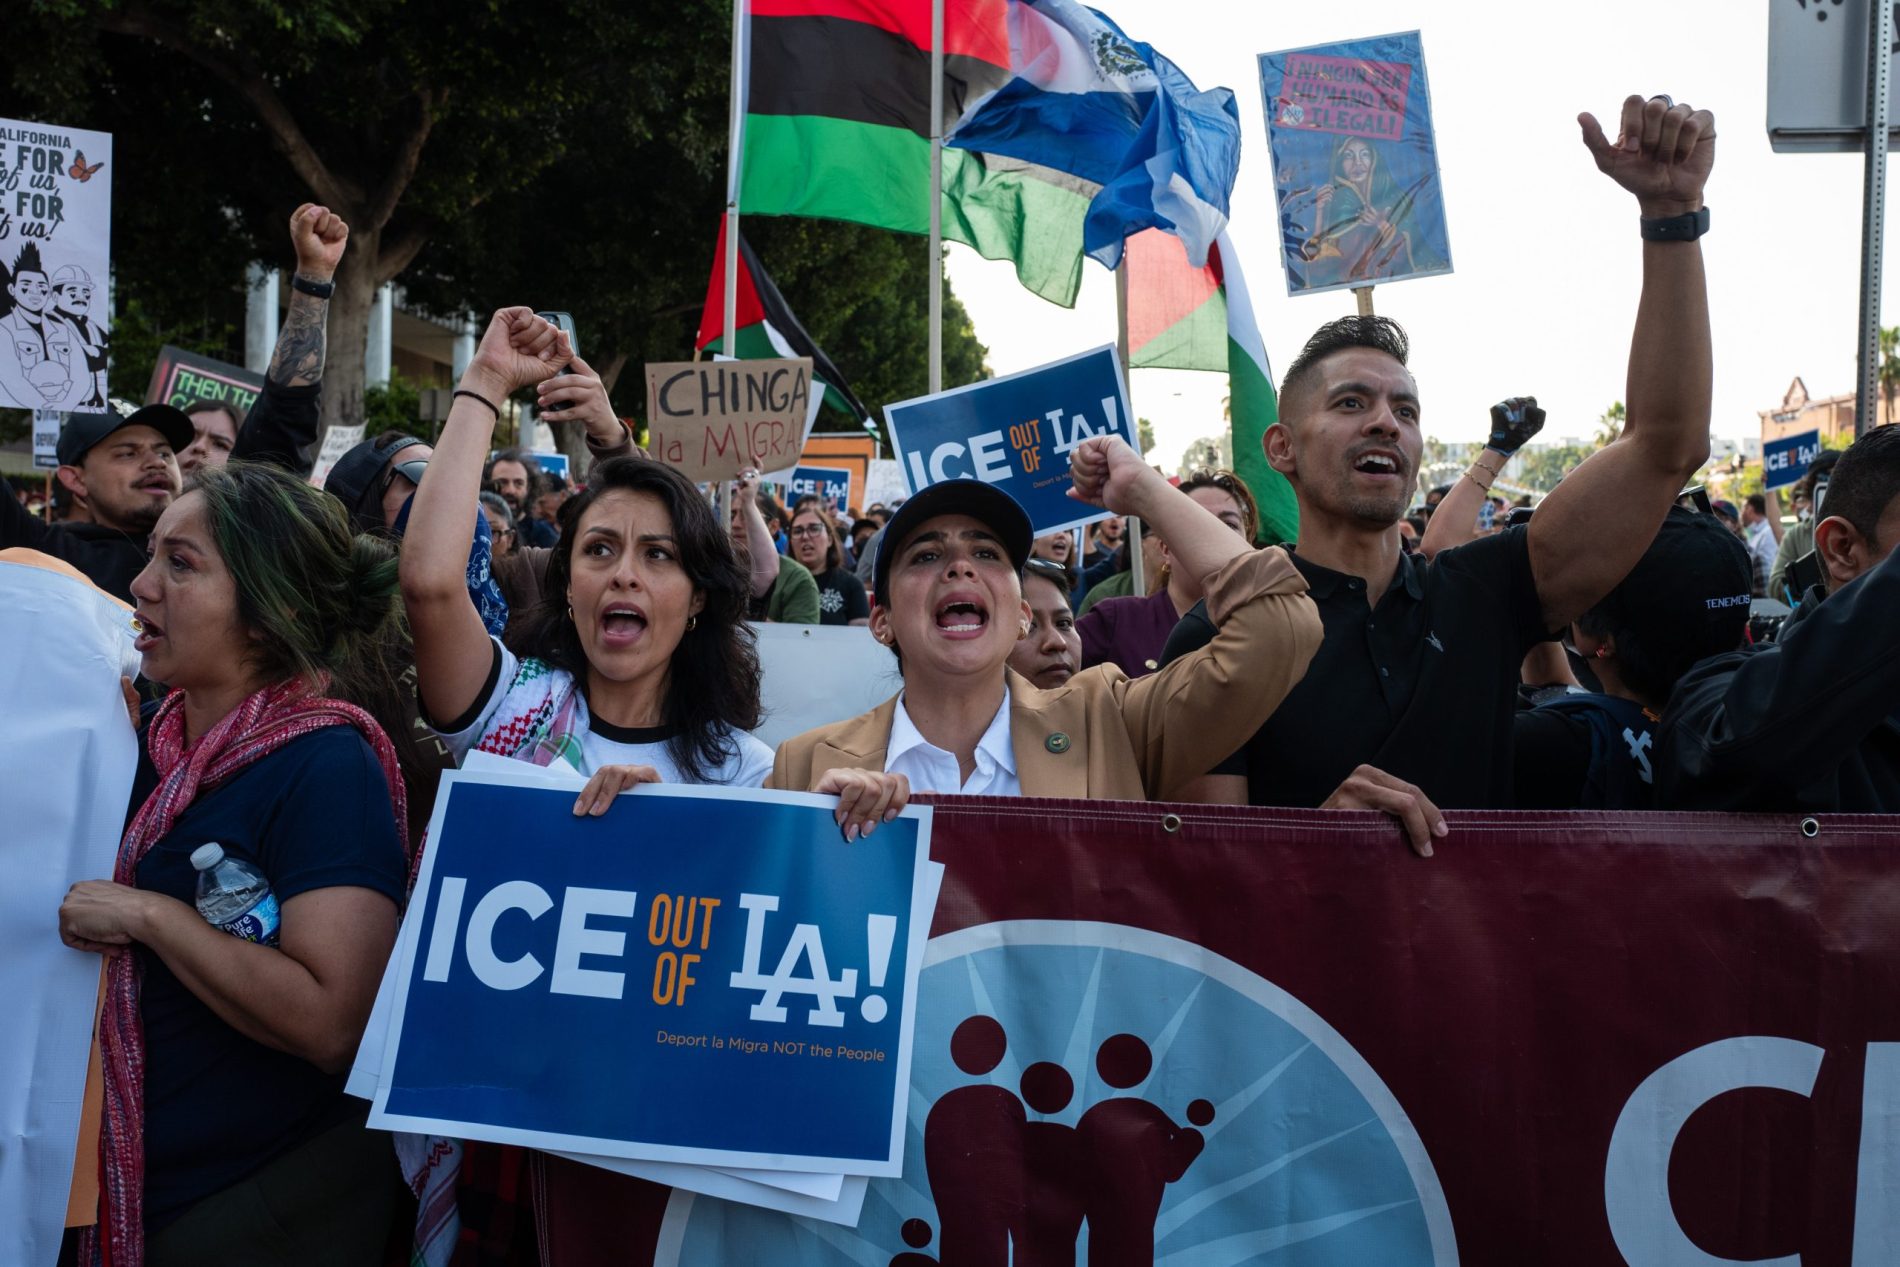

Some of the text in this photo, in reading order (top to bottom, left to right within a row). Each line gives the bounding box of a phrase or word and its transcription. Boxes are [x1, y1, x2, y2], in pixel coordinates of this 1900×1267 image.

[1311, 107, 1396, 135] ILEGAL!
[0, 127, 72, 149] ALIFORNIA
[17, 145, 65, 176] FOR
[16, 191, 65, 222] FOR
[177, 370, 258, 409] THEN TH
[658, 432, 683, 463] la
[1009, 419, 1041, 450] OUT
[907, 430, 1013, 496] ICE
[1021, 446, 1041, 473] OF
[1764, 451, 1788, 472] ICE
[788, 478, 815, 494] ICE
[1704, 594, 1750, 609] TENEMOS
[224, 915, 251, 931] Pure
[423, 876, 898, 1028] ICE OUT OF LA!
[656, 1030, 886, 1062] Deport la Migra NOT the People
